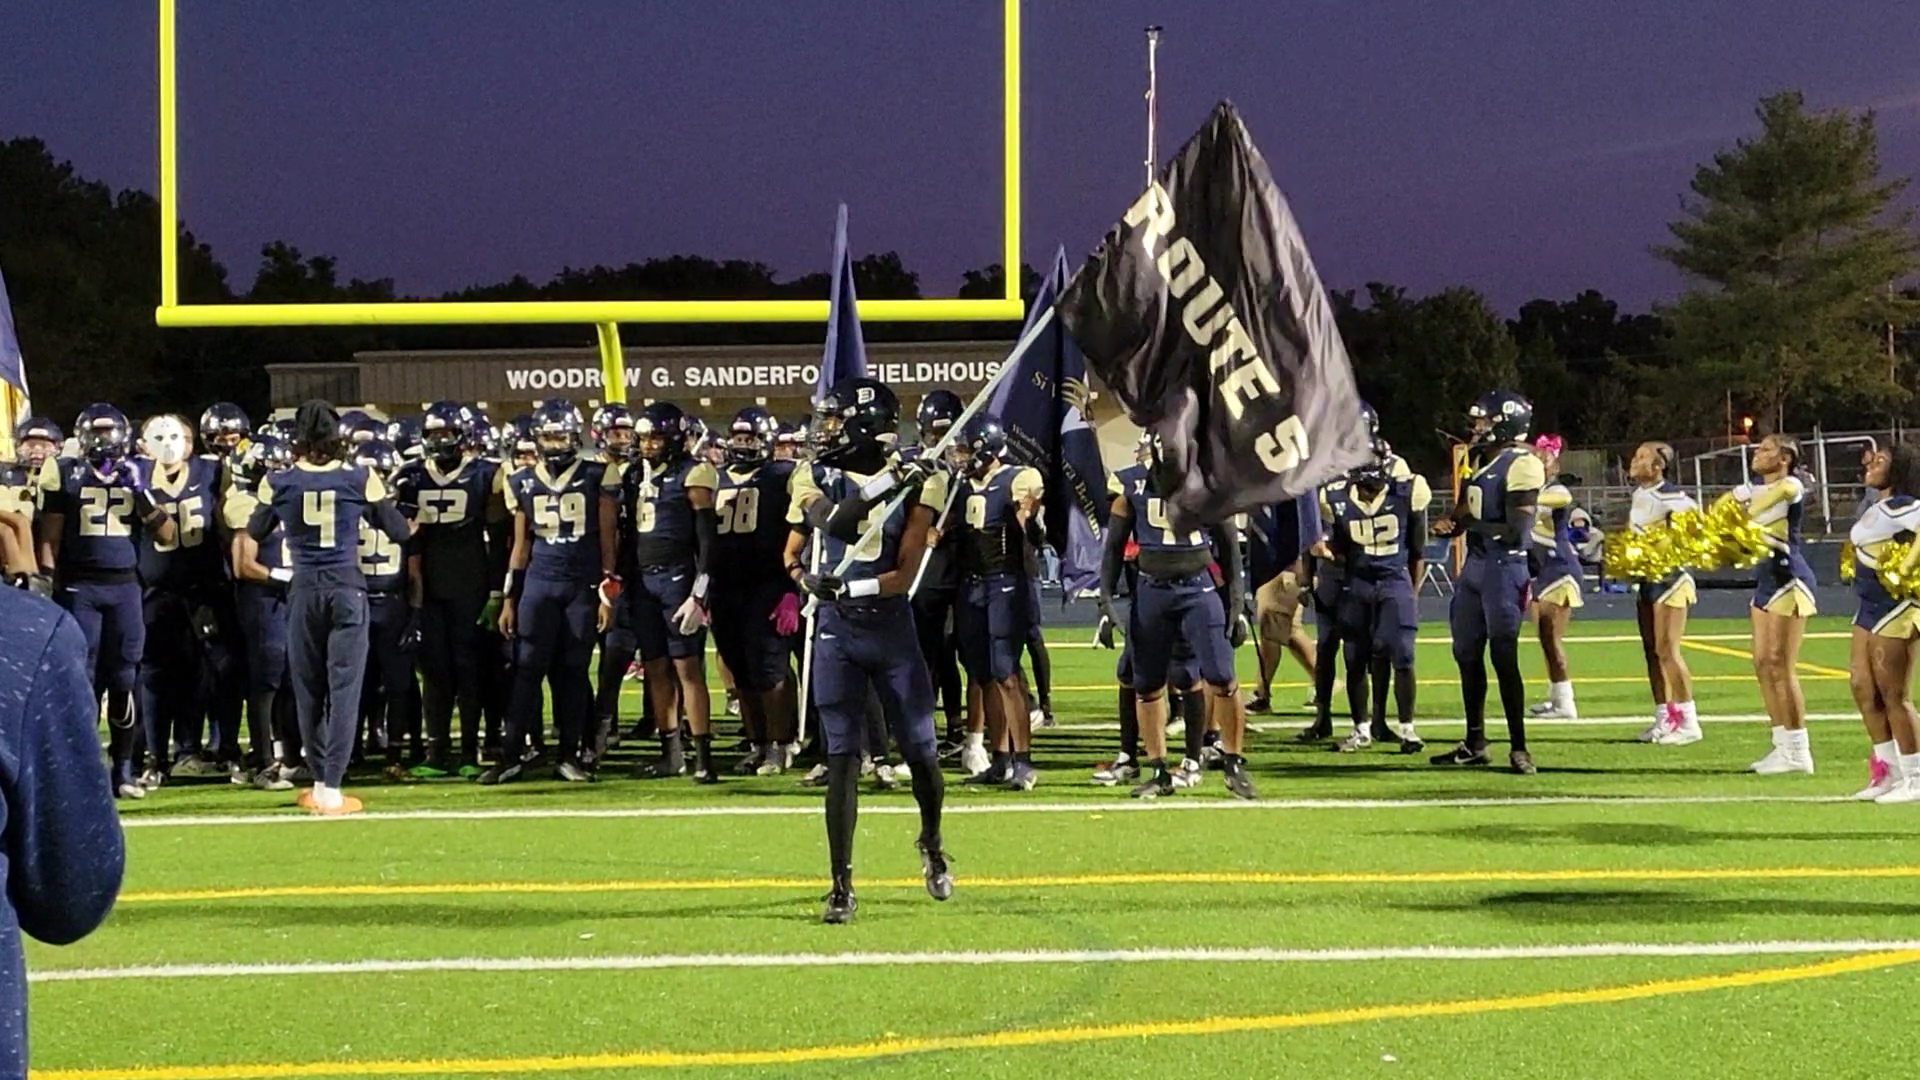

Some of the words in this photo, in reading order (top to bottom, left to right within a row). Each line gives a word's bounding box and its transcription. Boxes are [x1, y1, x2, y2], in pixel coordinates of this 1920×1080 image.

[1122, 179, 1282, 421] ROUTE
[651, 367, 675, 388] G.
[684, 365, 820, 387] SANDERFO
[866, 361, 1006, 383] FIELDHOUS
[79, 486, 135, 537] 22
[303, 489, 337, 548] 4
[533, 492, 586, 538] 59
[715, 487, 760, 534] 58
[1349, 513, 1400, 556] 42
